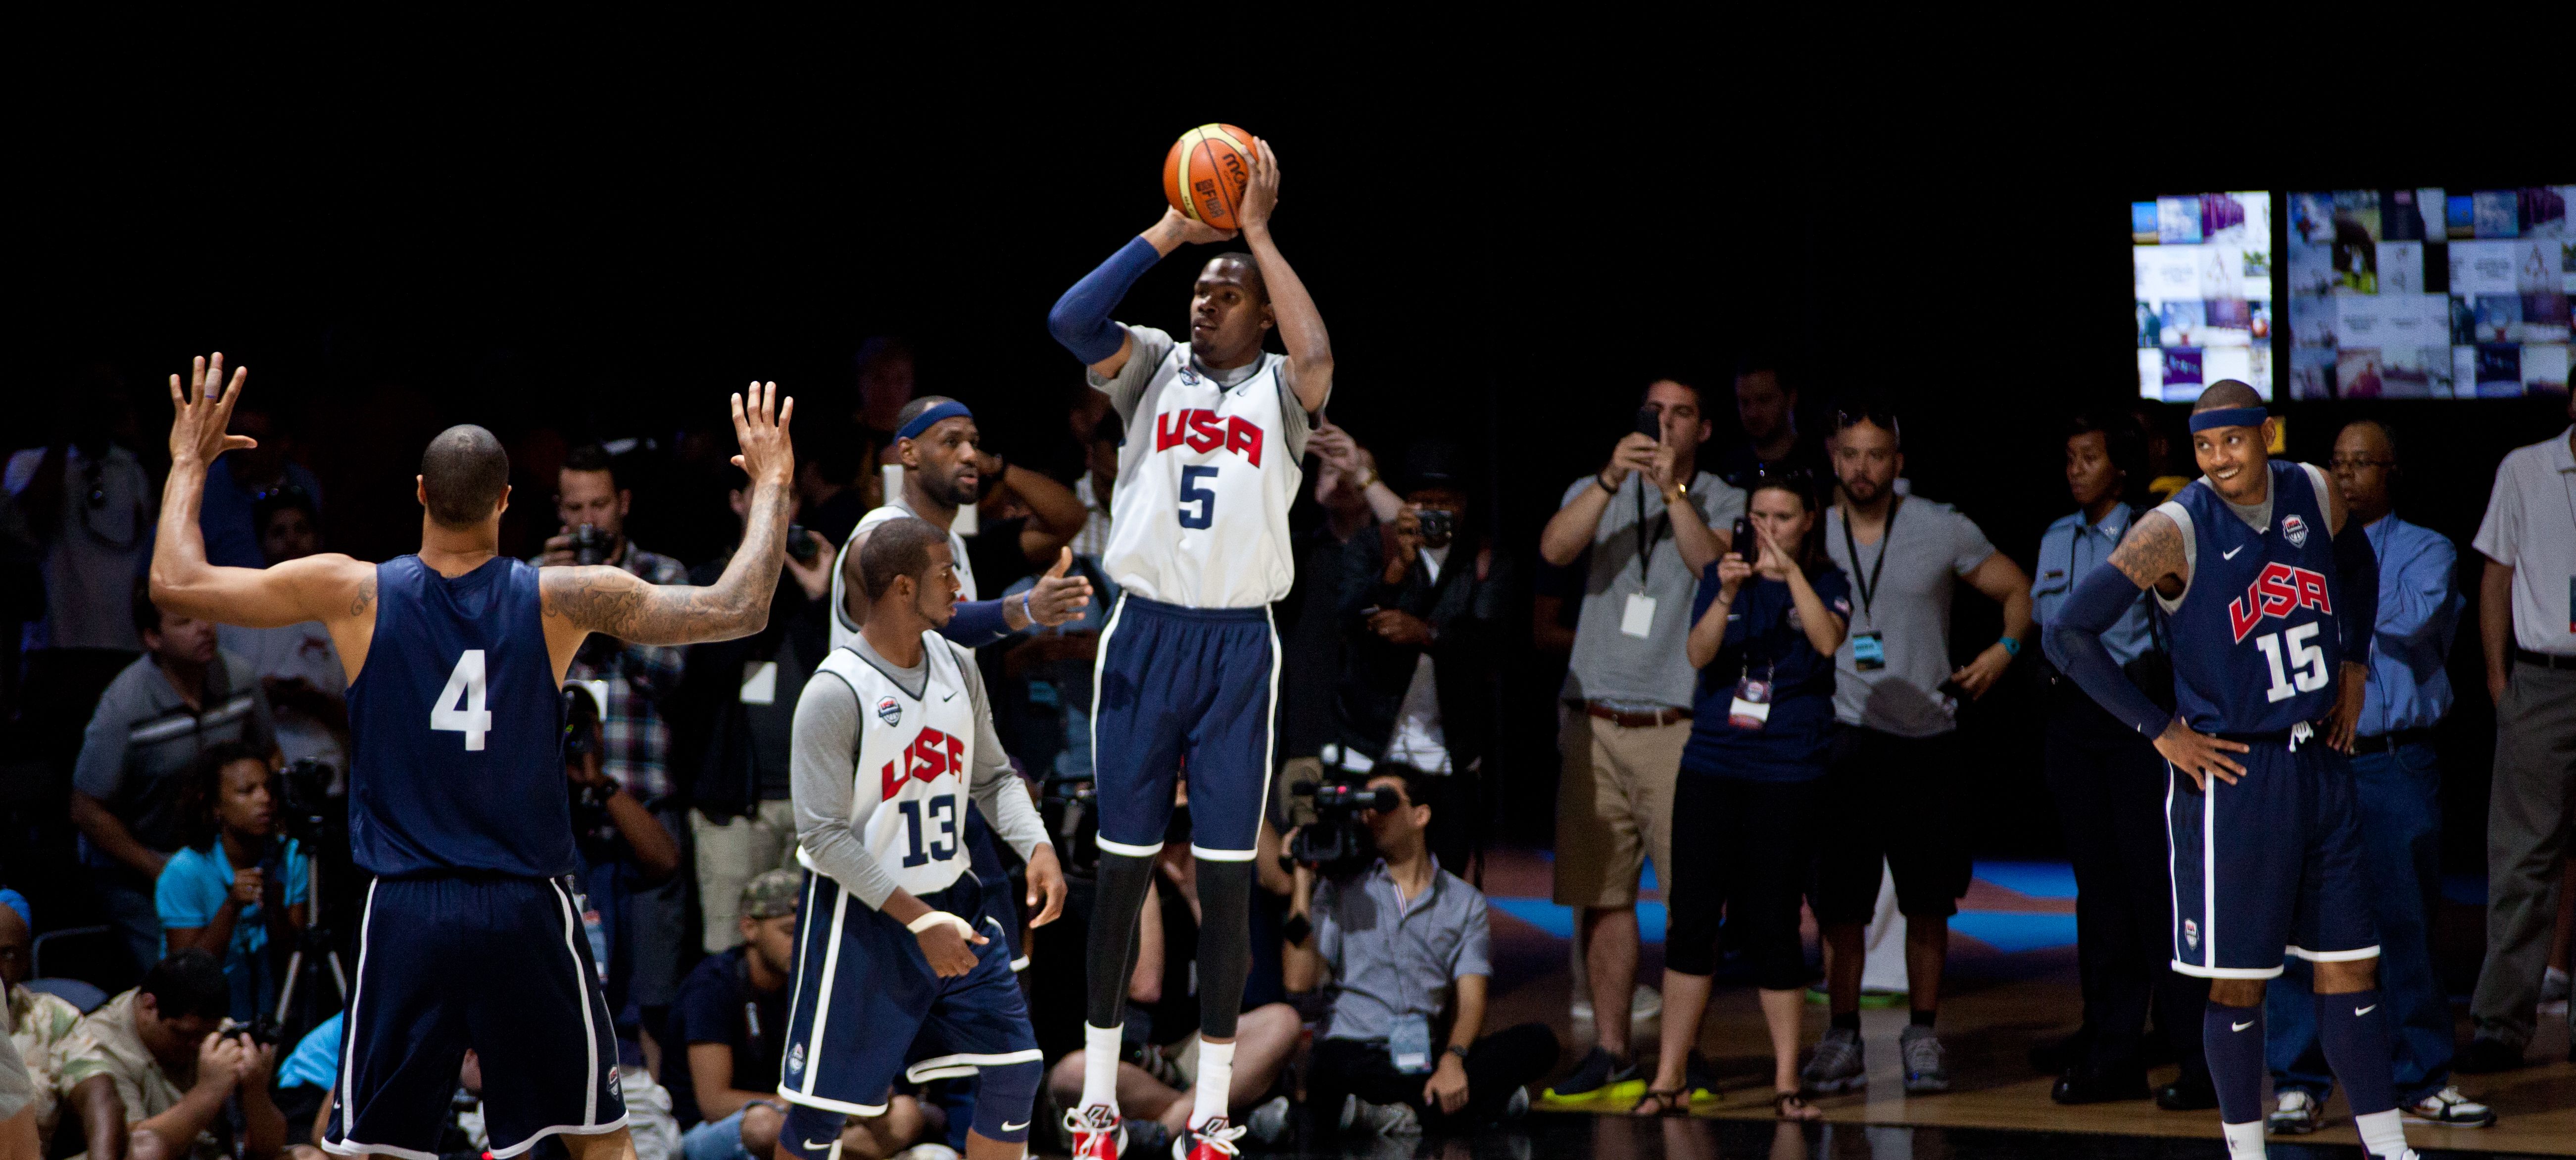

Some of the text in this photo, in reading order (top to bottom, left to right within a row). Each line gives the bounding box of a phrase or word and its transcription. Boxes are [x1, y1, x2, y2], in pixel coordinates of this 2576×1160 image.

[1156, 409, 1264, 468] USA
[1178, 465, 1218, 530] 5
[2229, 562, 2332, 644] USA
[431, 649, 492, 751] 4
[2256, 621, 2329, 703] 15
[881, 726, 965, 803] USA
[898, 794, 958, 869] 13
